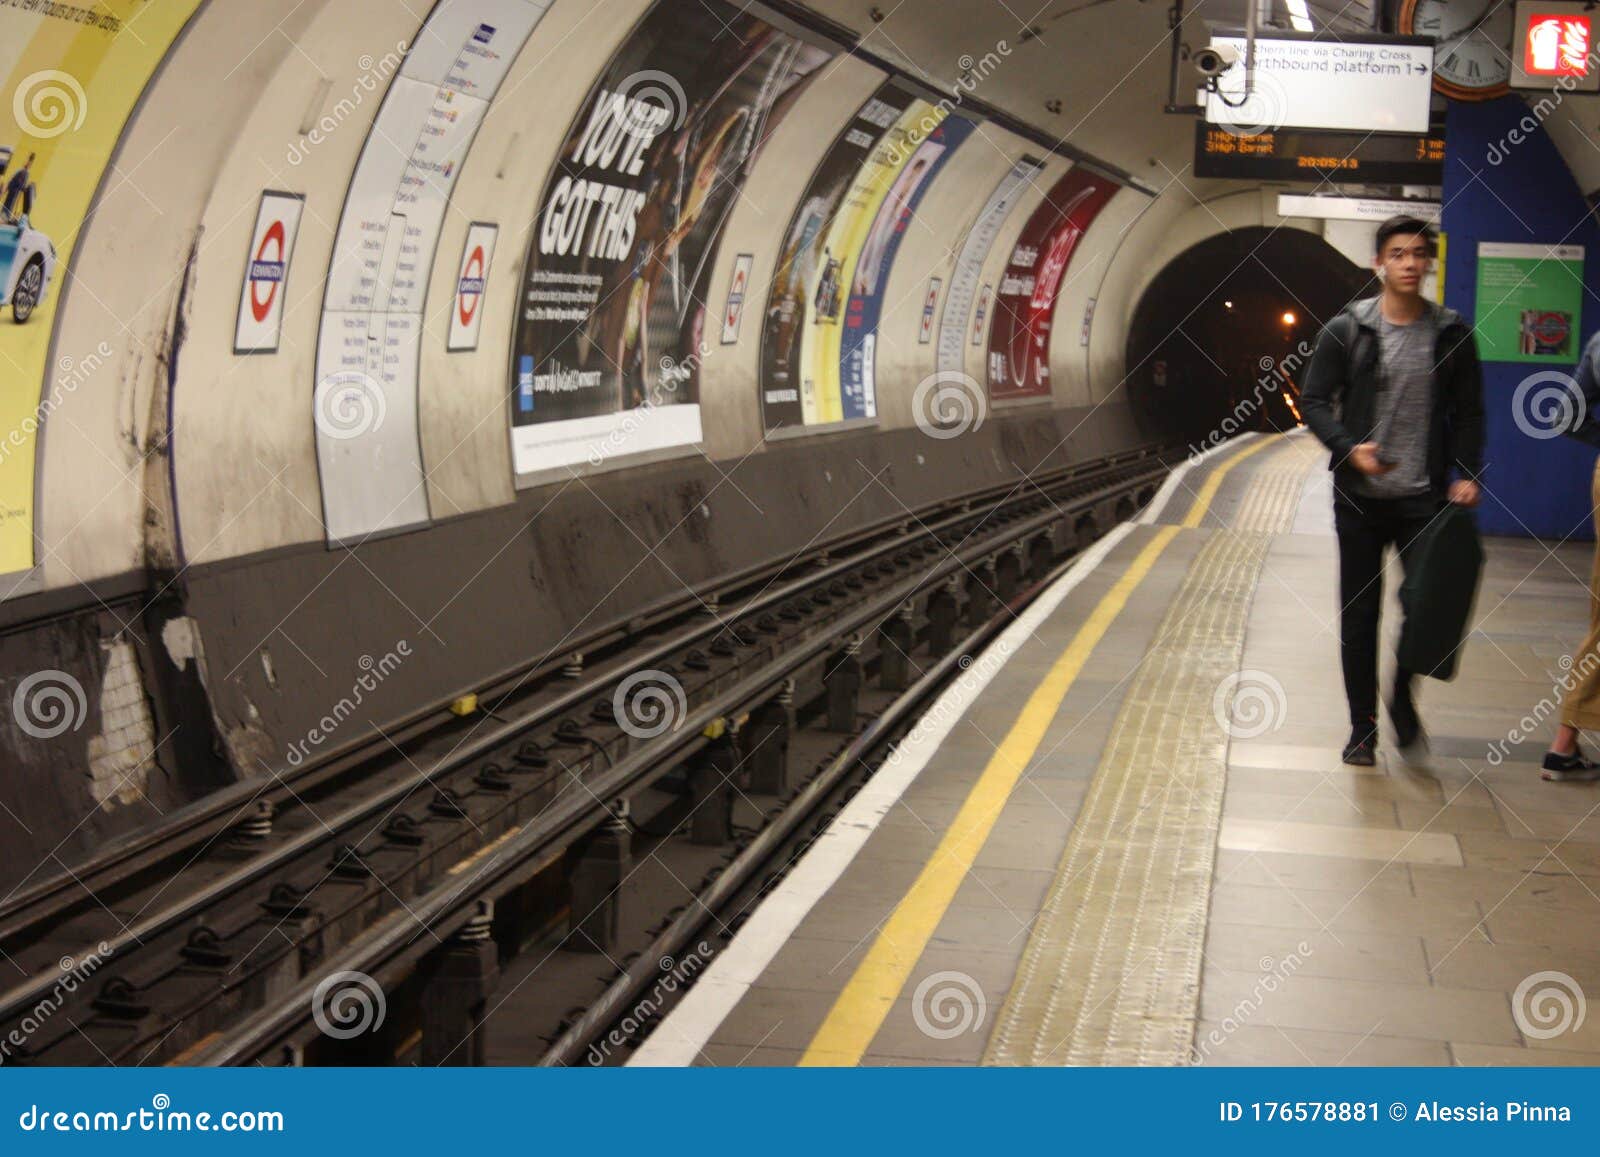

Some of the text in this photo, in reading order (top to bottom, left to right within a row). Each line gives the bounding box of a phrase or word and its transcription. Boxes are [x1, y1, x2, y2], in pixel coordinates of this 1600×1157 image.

[1289, 46, 1309, 56] line
[1314, 48, 1328, 57] via
[1333, 48, 1375, 61] Charing
[1379, 50, 1412, 61] Cross
[1334, 58, 1400, 75] platform
[1406, 63, 1412, 75] 1
[540, 176, 647, 262] GOT THIS
